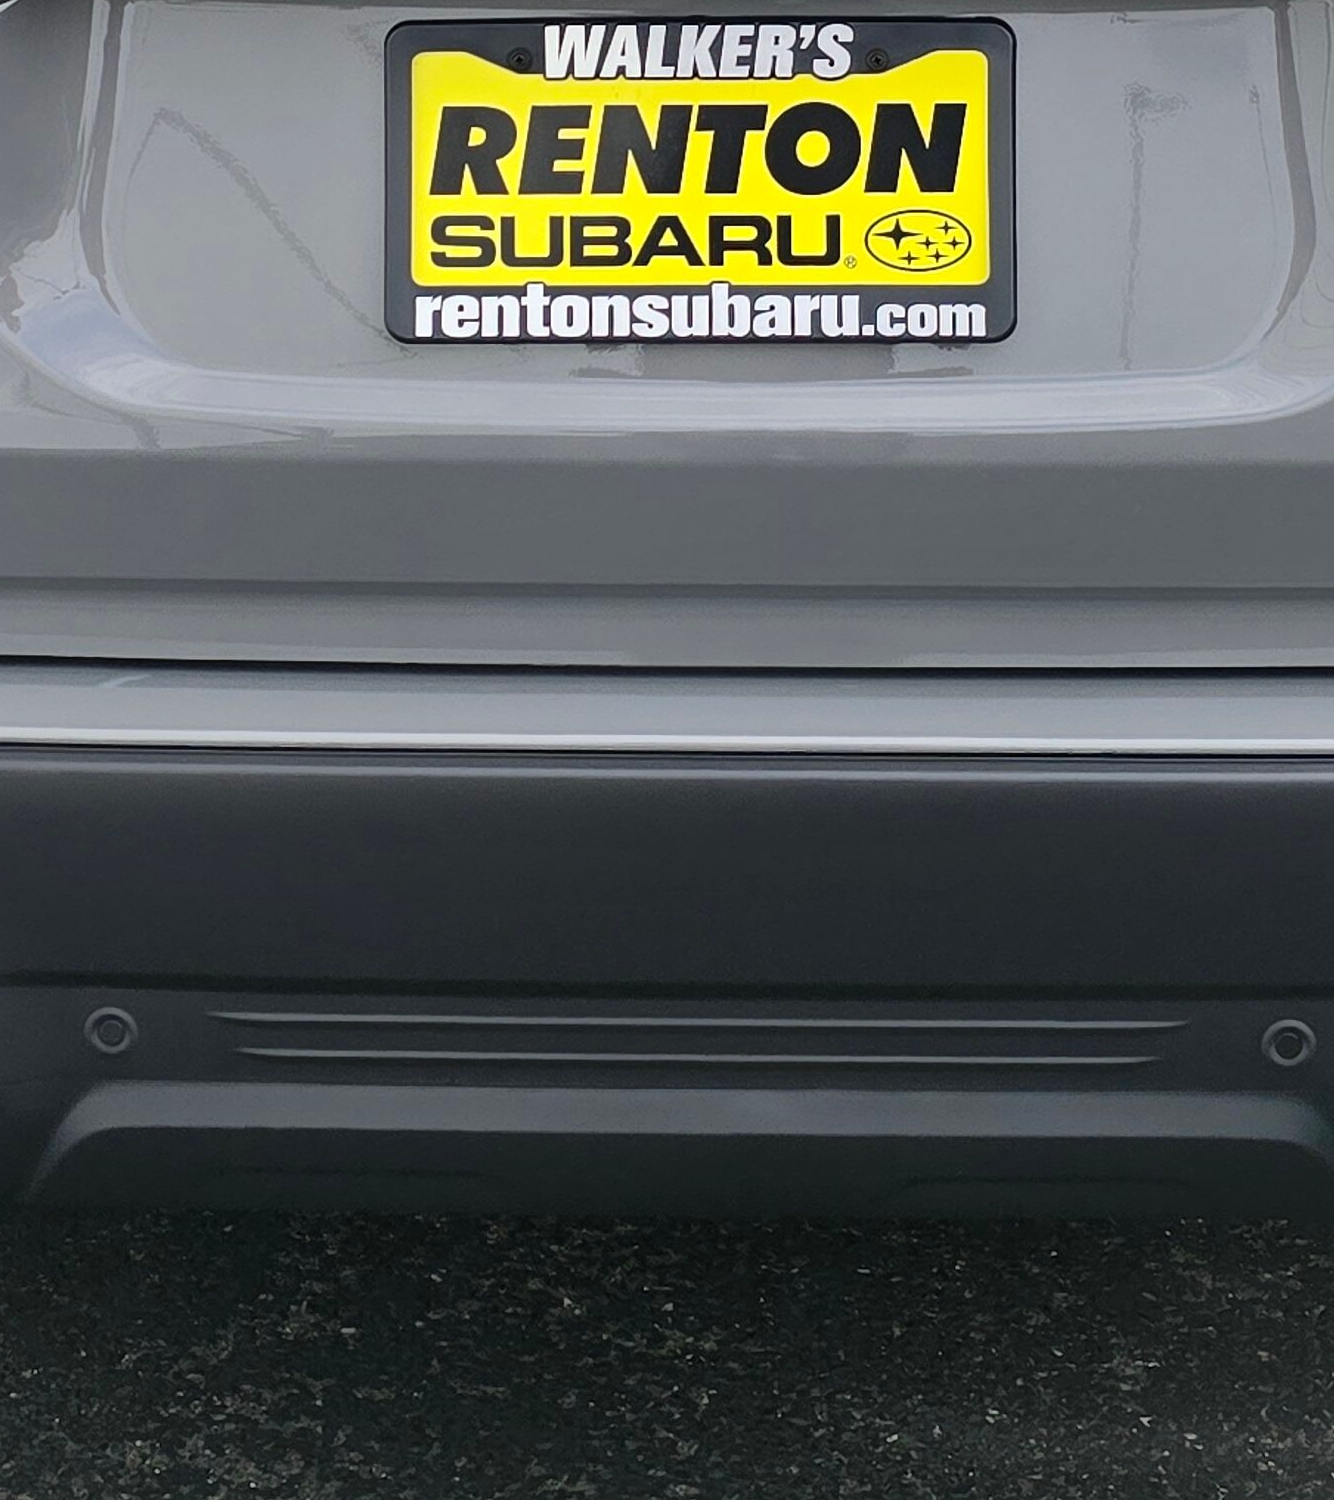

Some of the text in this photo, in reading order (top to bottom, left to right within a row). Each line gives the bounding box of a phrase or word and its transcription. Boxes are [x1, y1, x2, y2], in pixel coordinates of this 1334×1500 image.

[543, 23, 855, 80] WALKER'S
[429, 102, 966, 196] RENTON
[430, 215, 841, 268] SUBARU
[414, 283, 987, 338] rentonsubaru.com
